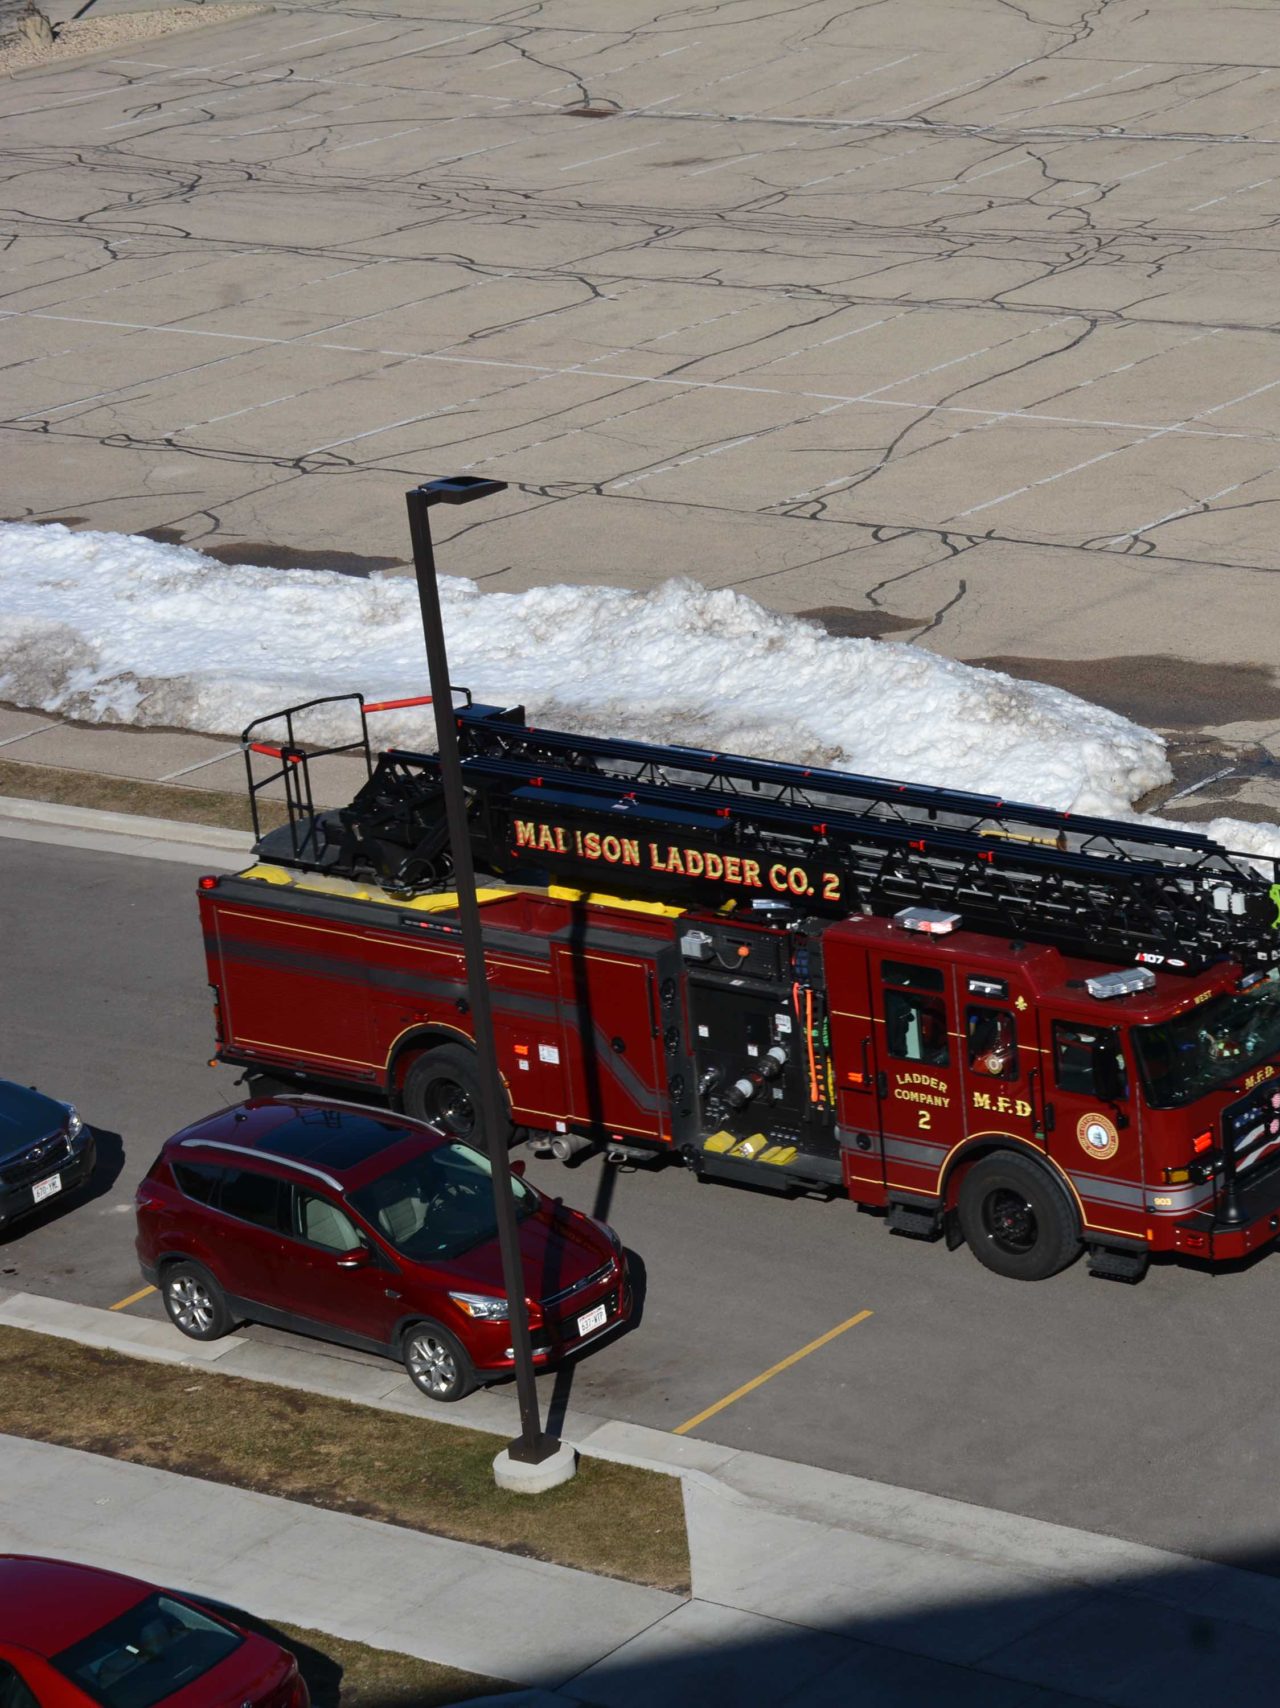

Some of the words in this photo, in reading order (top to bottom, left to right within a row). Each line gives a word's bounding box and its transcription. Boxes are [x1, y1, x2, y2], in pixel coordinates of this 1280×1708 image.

[649, 842, 763, 888] LADDER
[767, 863, 815, 897] CO.
[821, 872, 842, 901] 2
[895, 1072, 948, 1093] LADDER
[894, 1088, 951, 1109] COMPANY
[917, 1110, 932, 1130] 2
